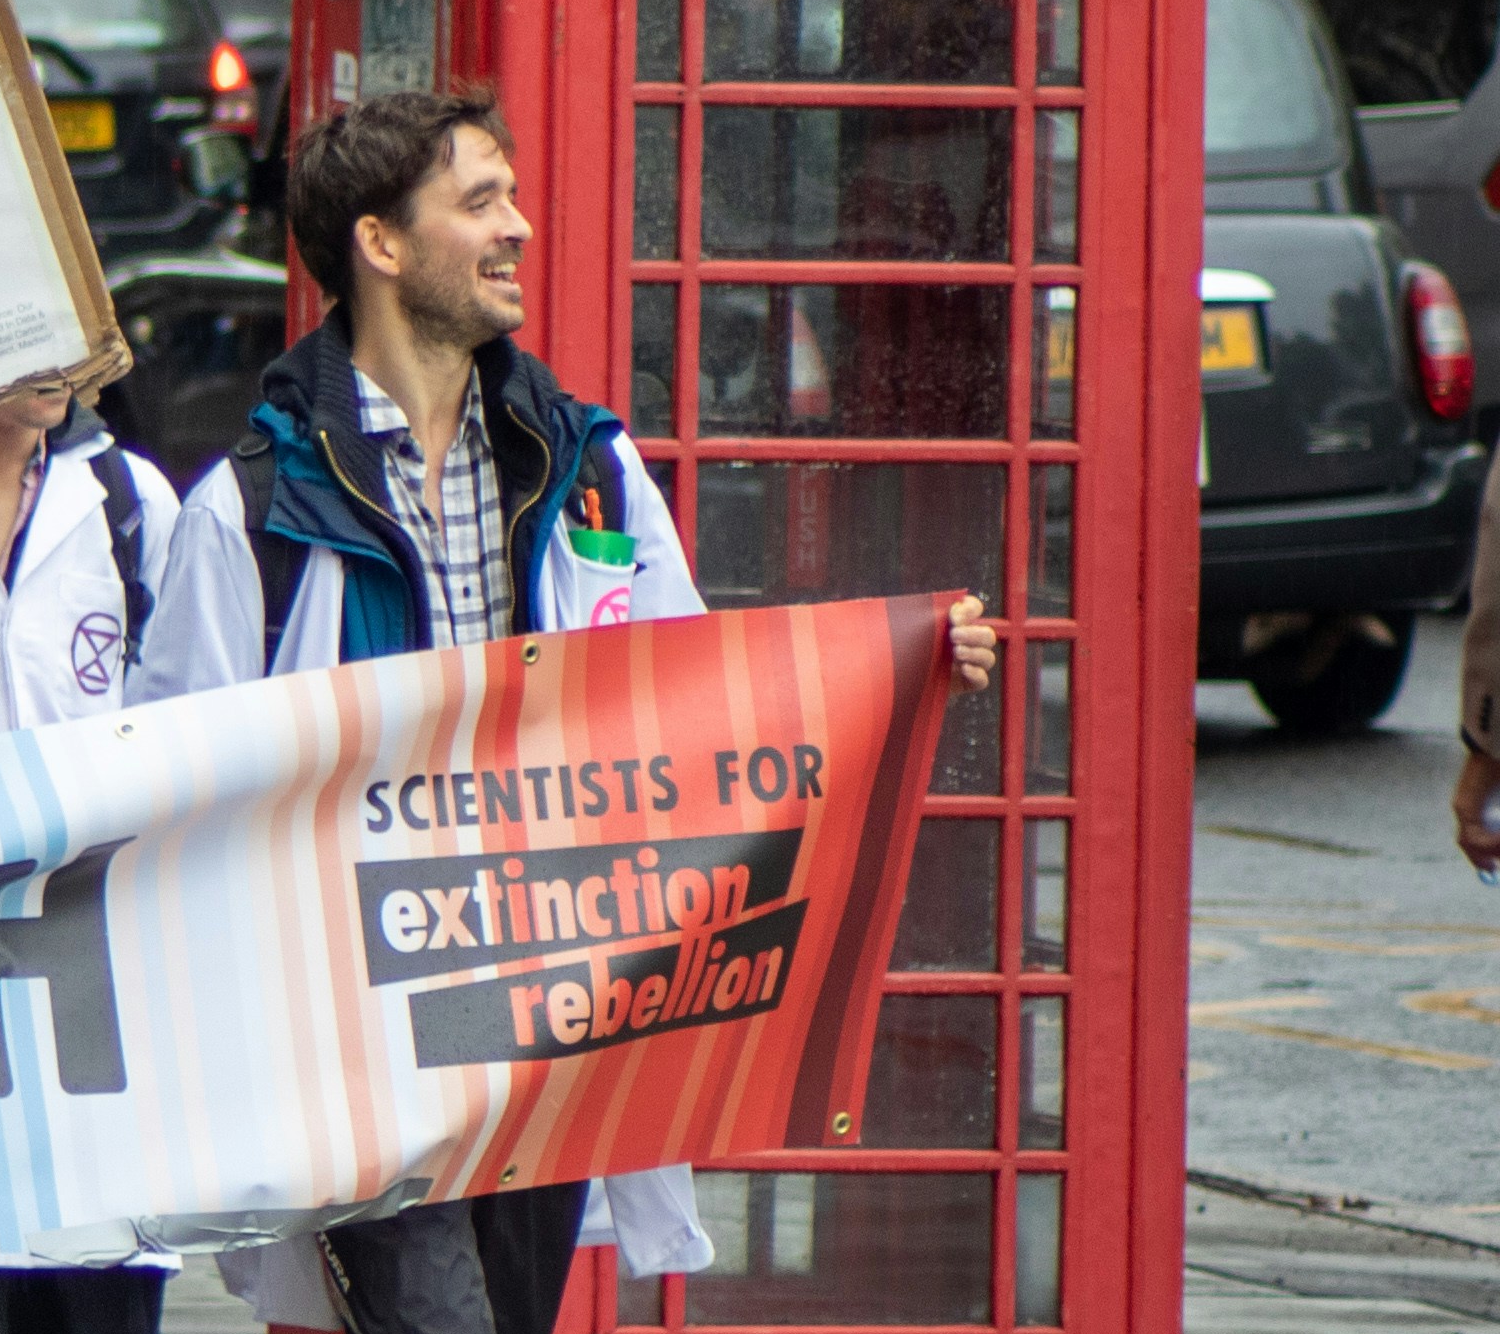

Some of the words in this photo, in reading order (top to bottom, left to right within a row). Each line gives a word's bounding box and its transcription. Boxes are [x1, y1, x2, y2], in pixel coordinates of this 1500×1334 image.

[13, 321, 47, 339] Carbon
[14, 312, 37, 326] Data
[37, 308, 46, 319] &
[16, 300, 35, 314] Our
[365, 754, 679, 834] SCIENTISTS
[714, 743, 824, 805] FOR
[380, 846, 752, 954] extinction
[509, 932, 786, 1047] rebellion
